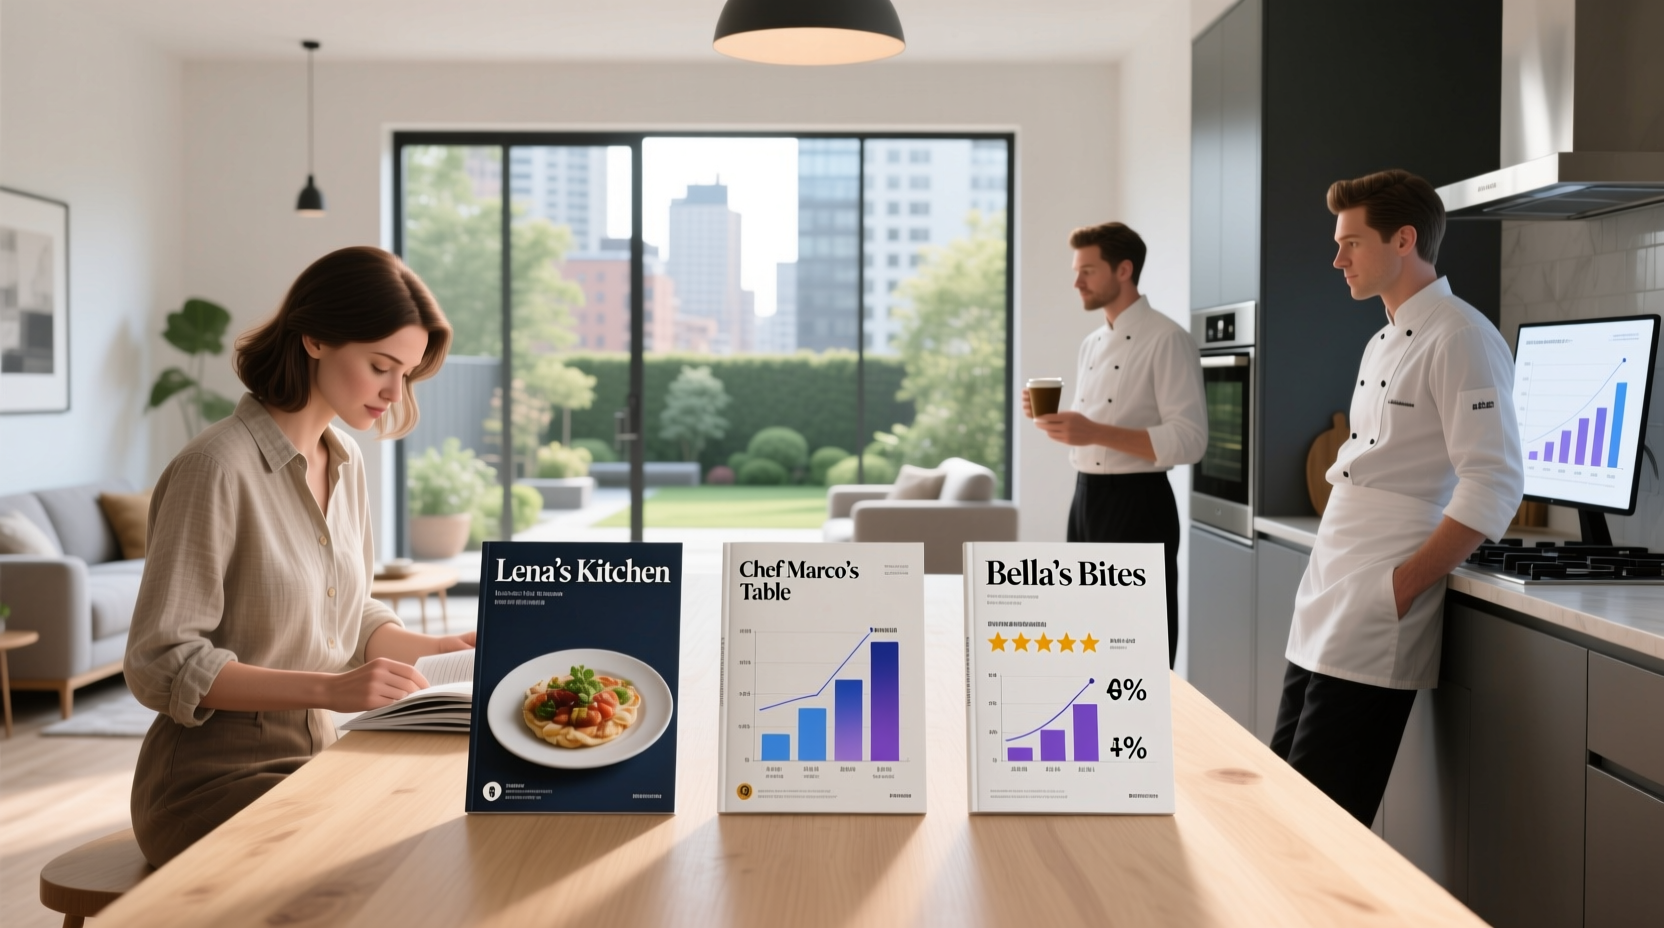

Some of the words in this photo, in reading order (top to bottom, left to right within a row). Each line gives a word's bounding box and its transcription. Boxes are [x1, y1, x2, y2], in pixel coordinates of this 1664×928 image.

[495, 557, 571, 582] Lena's
[575, 557, 671, 583] Kitchen
[739, 559, 785, 578] Chef
[787, 560, 859, 579] Marco's
[985, 558, 1073, 586] Bella's
[1077, 560, 1147, 587] Bites
[739, 581, 791, 601] Table
